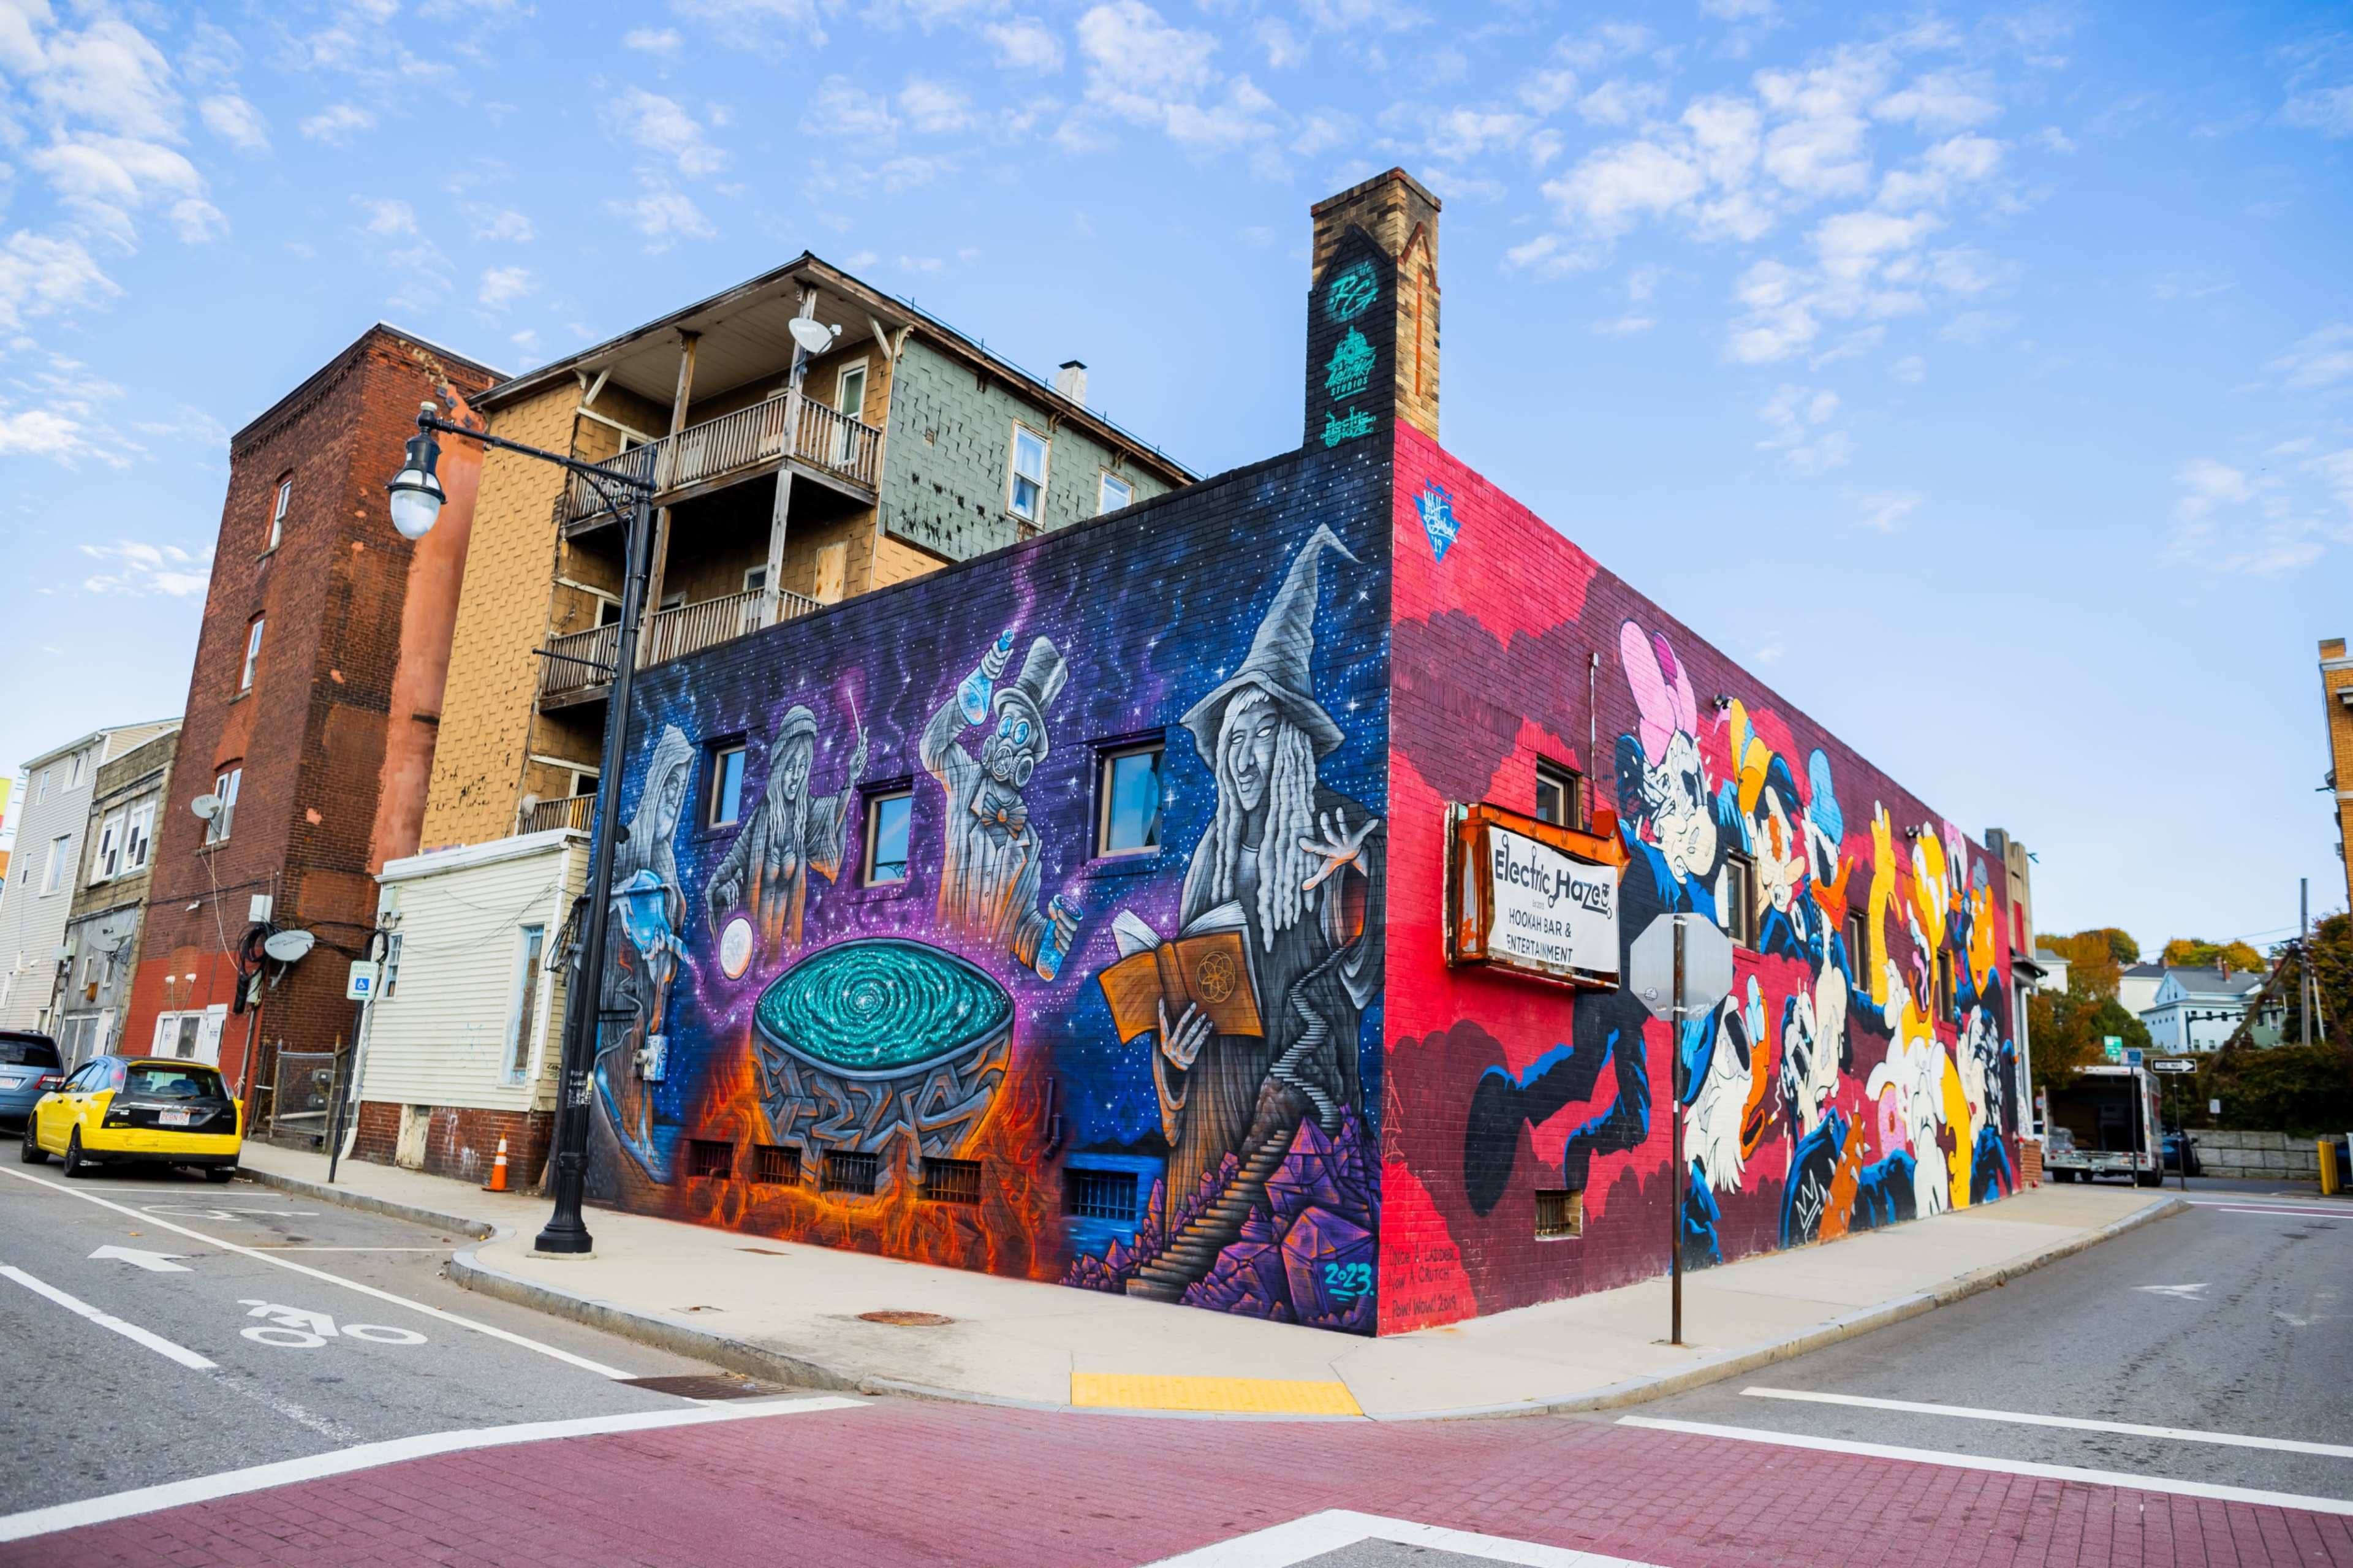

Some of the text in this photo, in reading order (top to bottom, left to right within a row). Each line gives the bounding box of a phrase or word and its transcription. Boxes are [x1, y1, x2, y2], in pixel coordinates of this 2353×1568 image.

[1330, 376, 1368, 396] STUDIOS
[1495, 834, 1613, 919] Electric Haze
[1509, 908, 1572, 937] HOOKAH BAR &
[1507, 934, 1573, 963] ENTERTAINMENT
[1410, 1268, 1415, 1284] A
